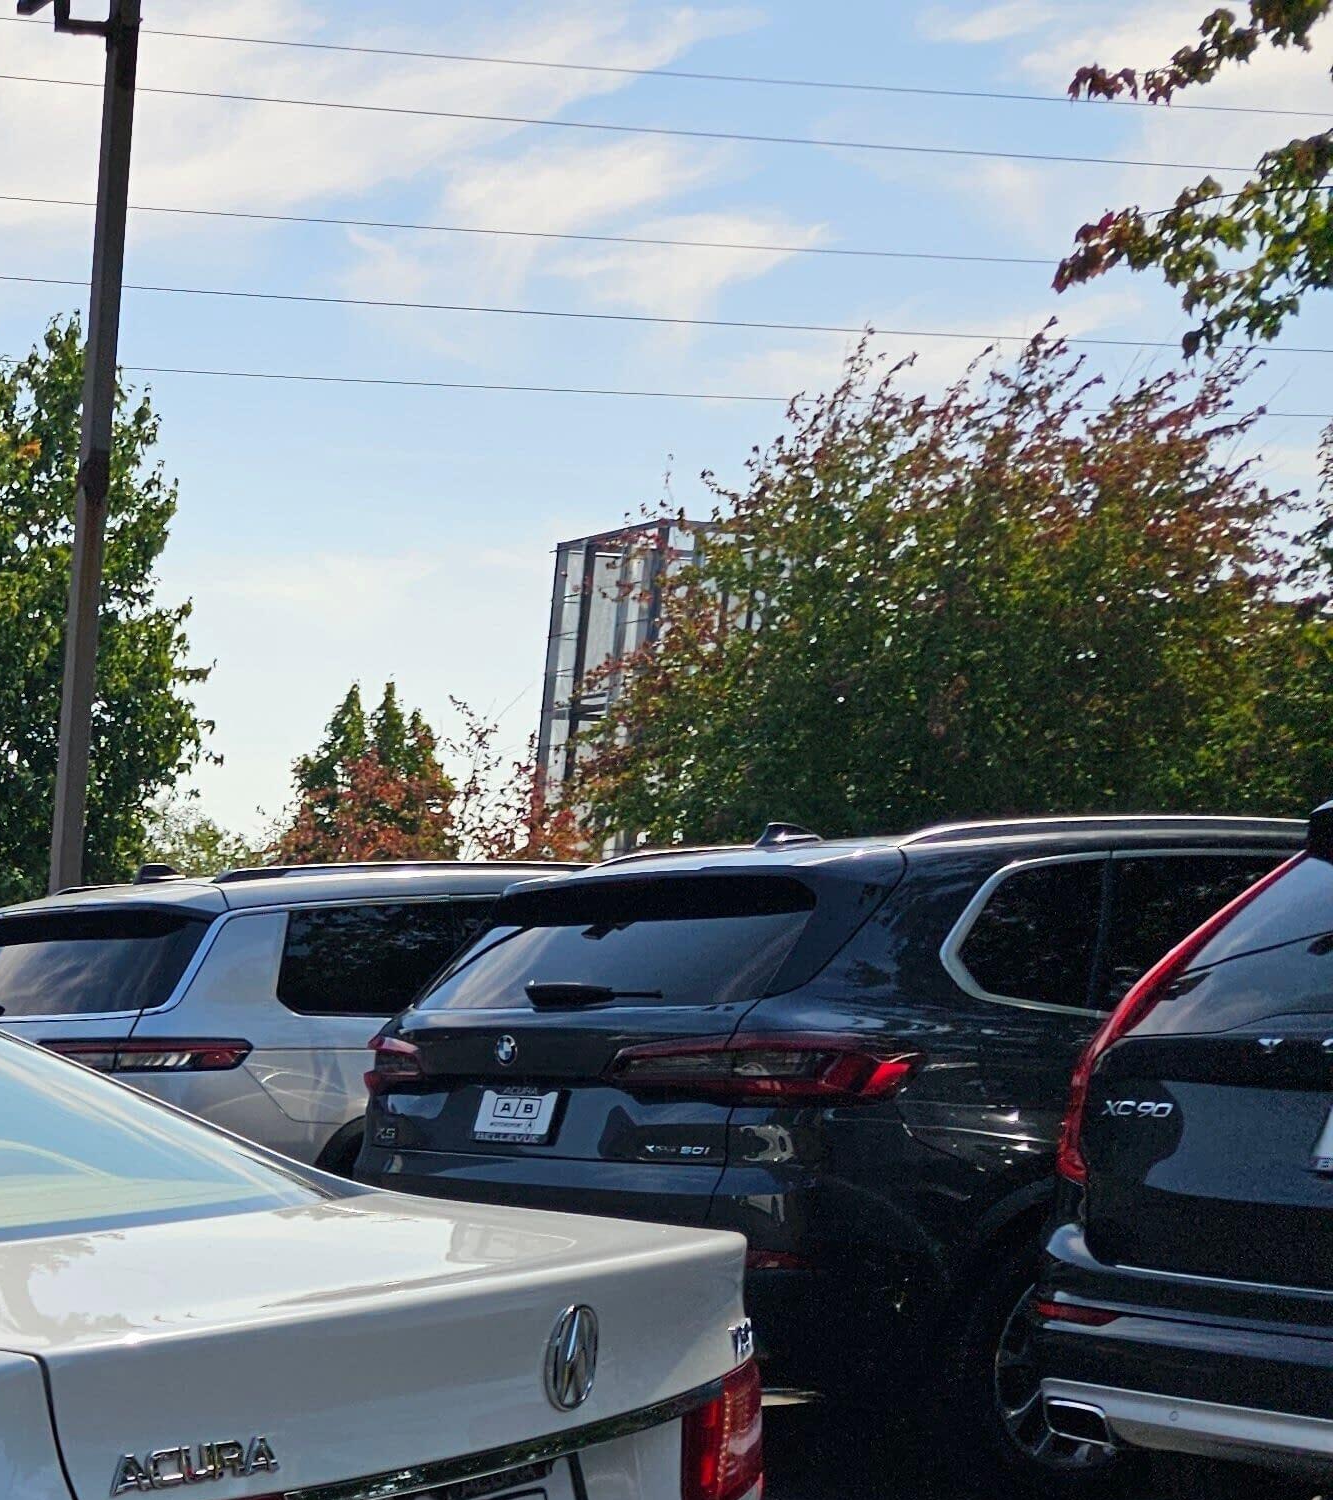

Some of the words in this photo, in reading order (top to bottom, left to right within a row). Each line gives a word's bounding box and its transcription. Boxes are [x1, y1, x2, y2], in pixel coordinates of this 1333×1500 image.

[500, 1103, 511, 1113] A
[523, 1103, 534, 1114] B
[1101, 1099, 1174, 1118] XC90
[475, 1132, 540, 1143] BELLEVUE
[109, 1435, 281, 1498] ACURA
